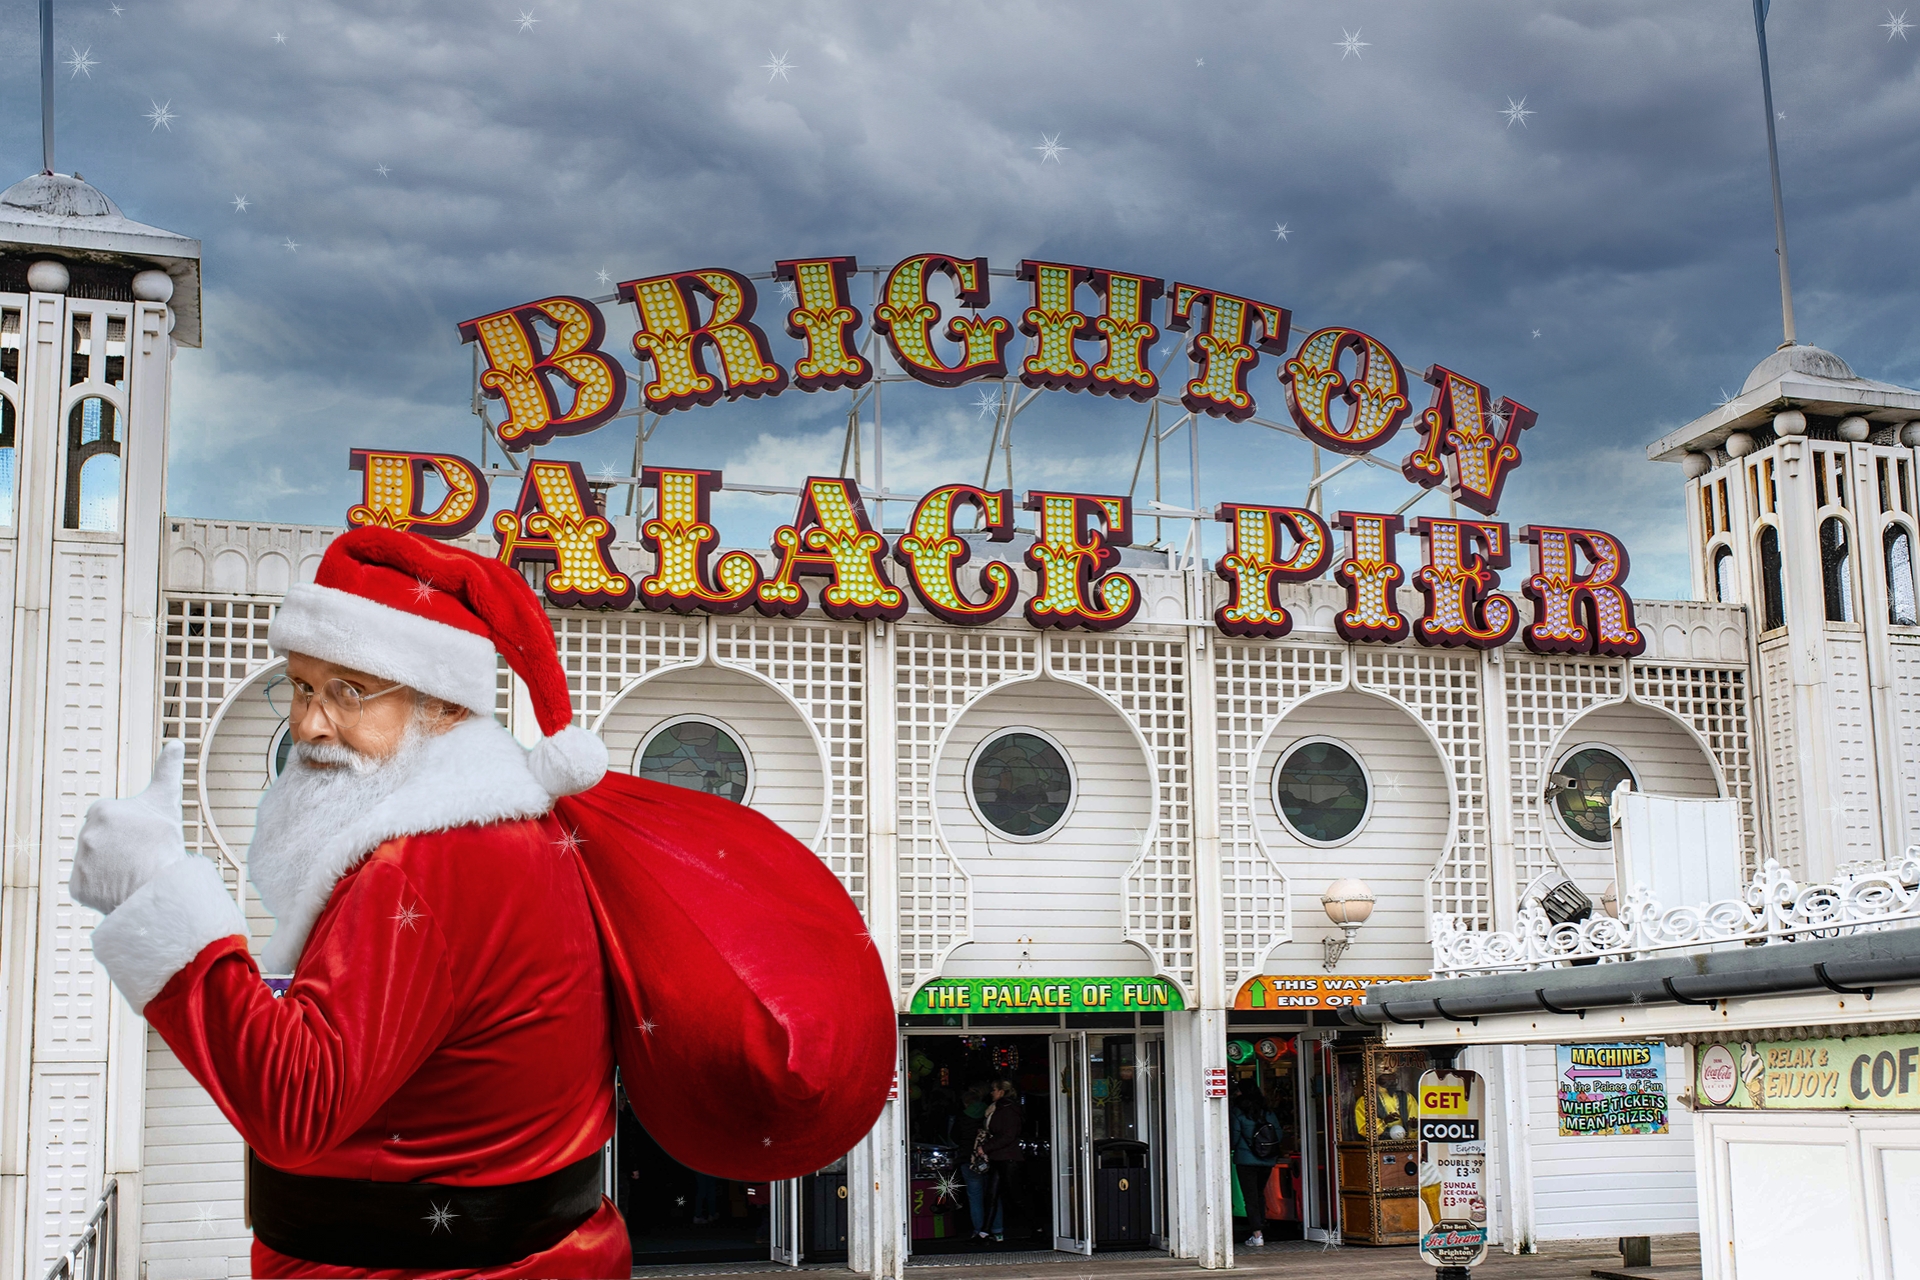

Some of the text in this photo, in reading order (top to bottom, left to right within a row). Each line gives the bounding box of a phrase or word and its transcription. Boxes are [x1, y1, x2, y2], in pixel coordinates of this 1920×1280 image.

[456, 253, 1539, 516] BRIGHTON
[347, 447, 1647, 658] PALACE PIER
[1273, 980, 1318, 991] THIS
[1324, 980, 1371, 990] WAY
[924, 984, 1169, 1008] THE PALACE OF FUN
[1277, 996, 1319, 1006] END
[1326, 996, 1352, 1006] OF
[1383, 1052, 1427, 1071] ZOLTAR
[1571, 1048, 1651, 1067] MACHINES
[1767, 1048, 1829, 1069] RELAX &
[1625, 1068, 1658, 1079] HERE
[1560, 1080, 1663, 1093] In the Palace of Fun
[1766, 1071, 1840, 1098] ENJOY!
[1424, 1092, 1461, 1109] GET
[1560, 1094, 1666, 1115] WHERE TICKETS
[1423, 1124, 1475, 1139] COOL!
[1566, 1116, 1606, 1131] MEAN
[1456, 1168, 1480, 1177] £3.50
[1443, 1197, 1467, 1207] £3.90
[1425, 1231, 1481, 1247] Ice Cream
